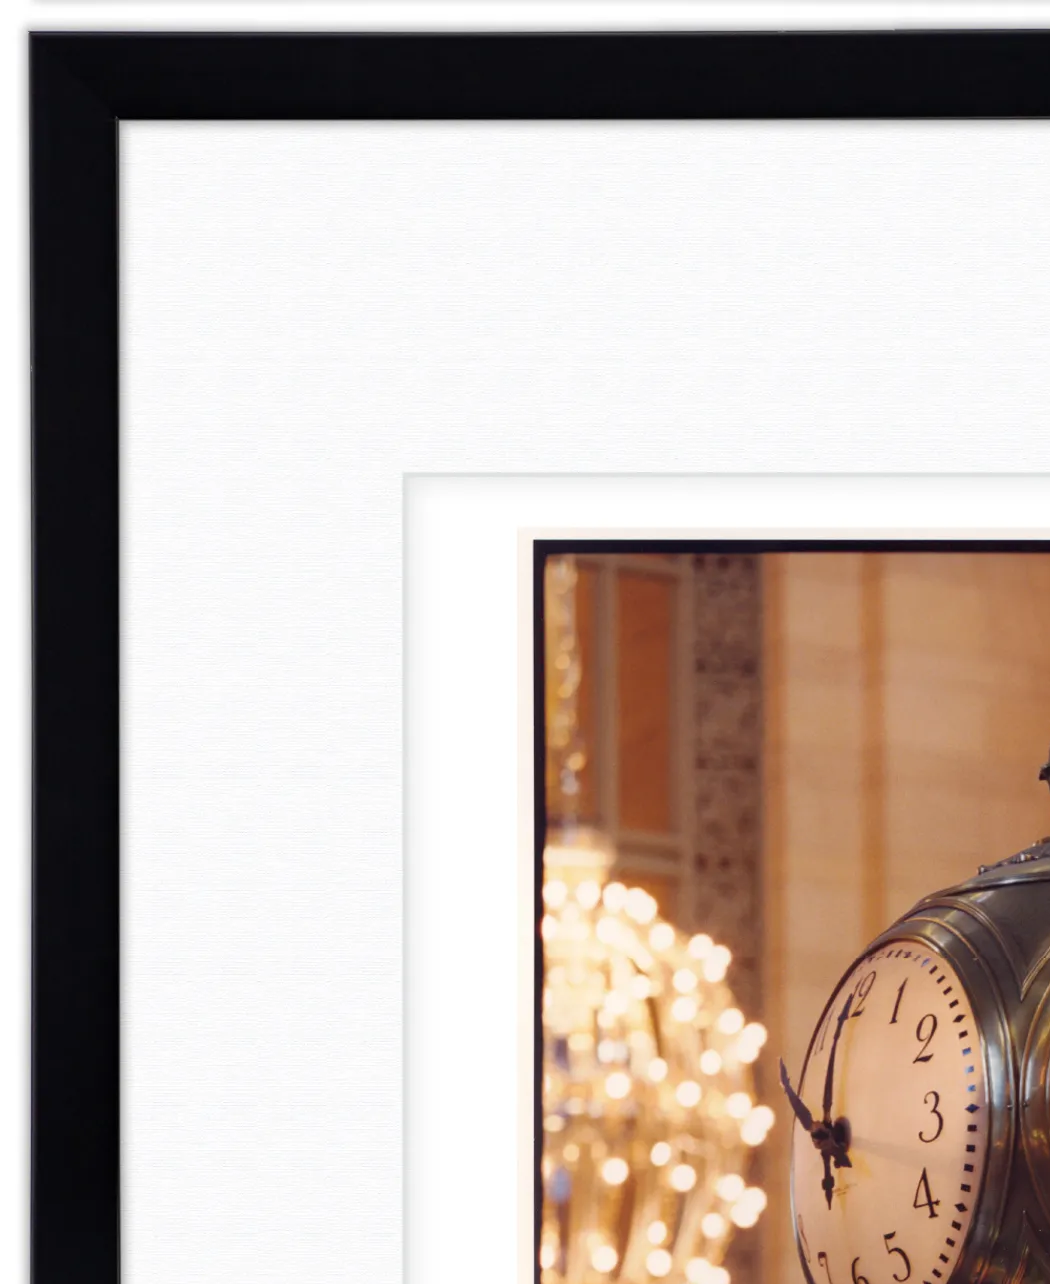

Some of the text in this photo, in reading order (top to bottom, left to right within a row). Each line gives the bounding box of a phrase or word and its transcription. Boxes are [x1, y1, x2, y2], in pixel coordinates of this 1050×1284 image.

[889, 977, 909, 1024] 1
[913, 1013, 938, 1064] 2
[918, 1090, 944, 1143] 3
[912, 1166, 940, 1219] 4
[883, 1230, 912, 1283] 5
